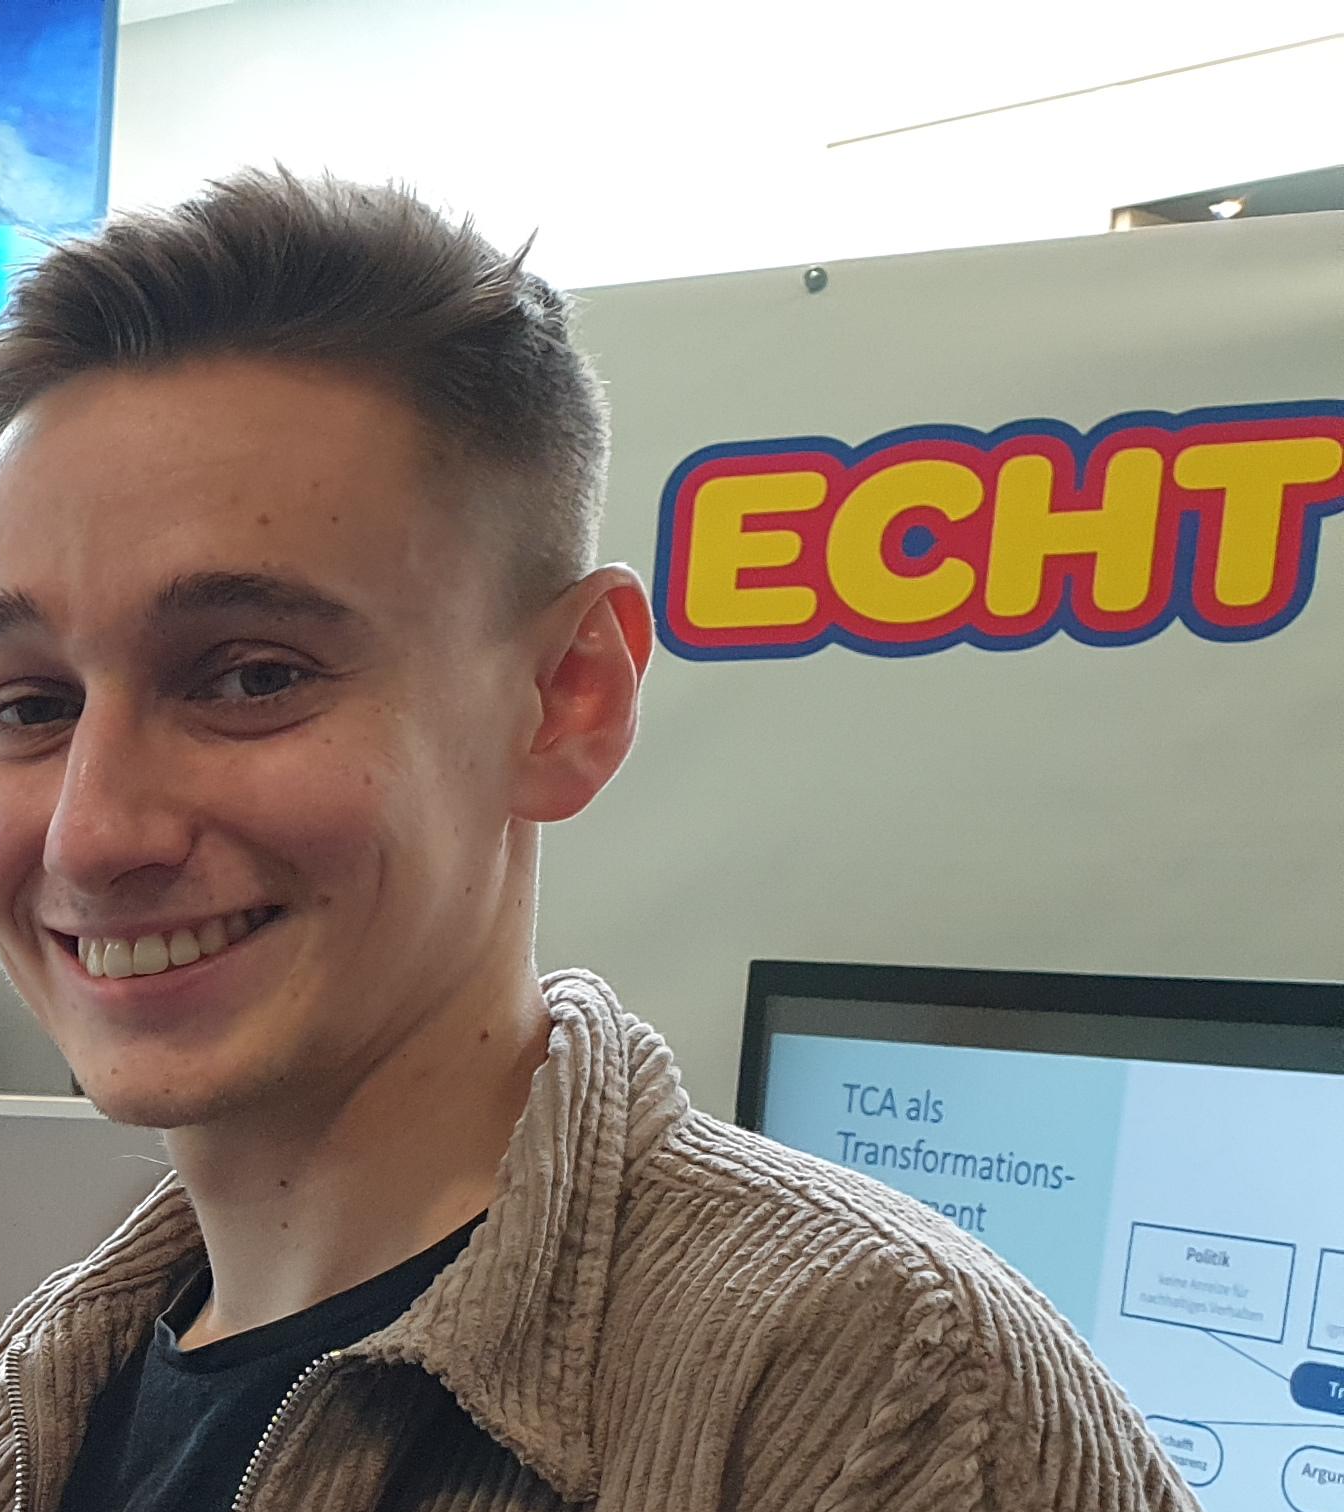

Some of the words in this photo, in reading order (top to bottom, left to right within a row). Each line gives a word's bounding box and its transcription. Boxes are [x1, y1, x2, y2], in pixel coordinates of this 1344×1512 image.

[683, 434, 1344, 631] ECHT
[842, 1082, 898, 1119] TCA
[905, 1088, 945, 1124] als
[836, 1130, 1077, 1190] Transformations-
[1185, 1246, 1232, 1268] Politik
